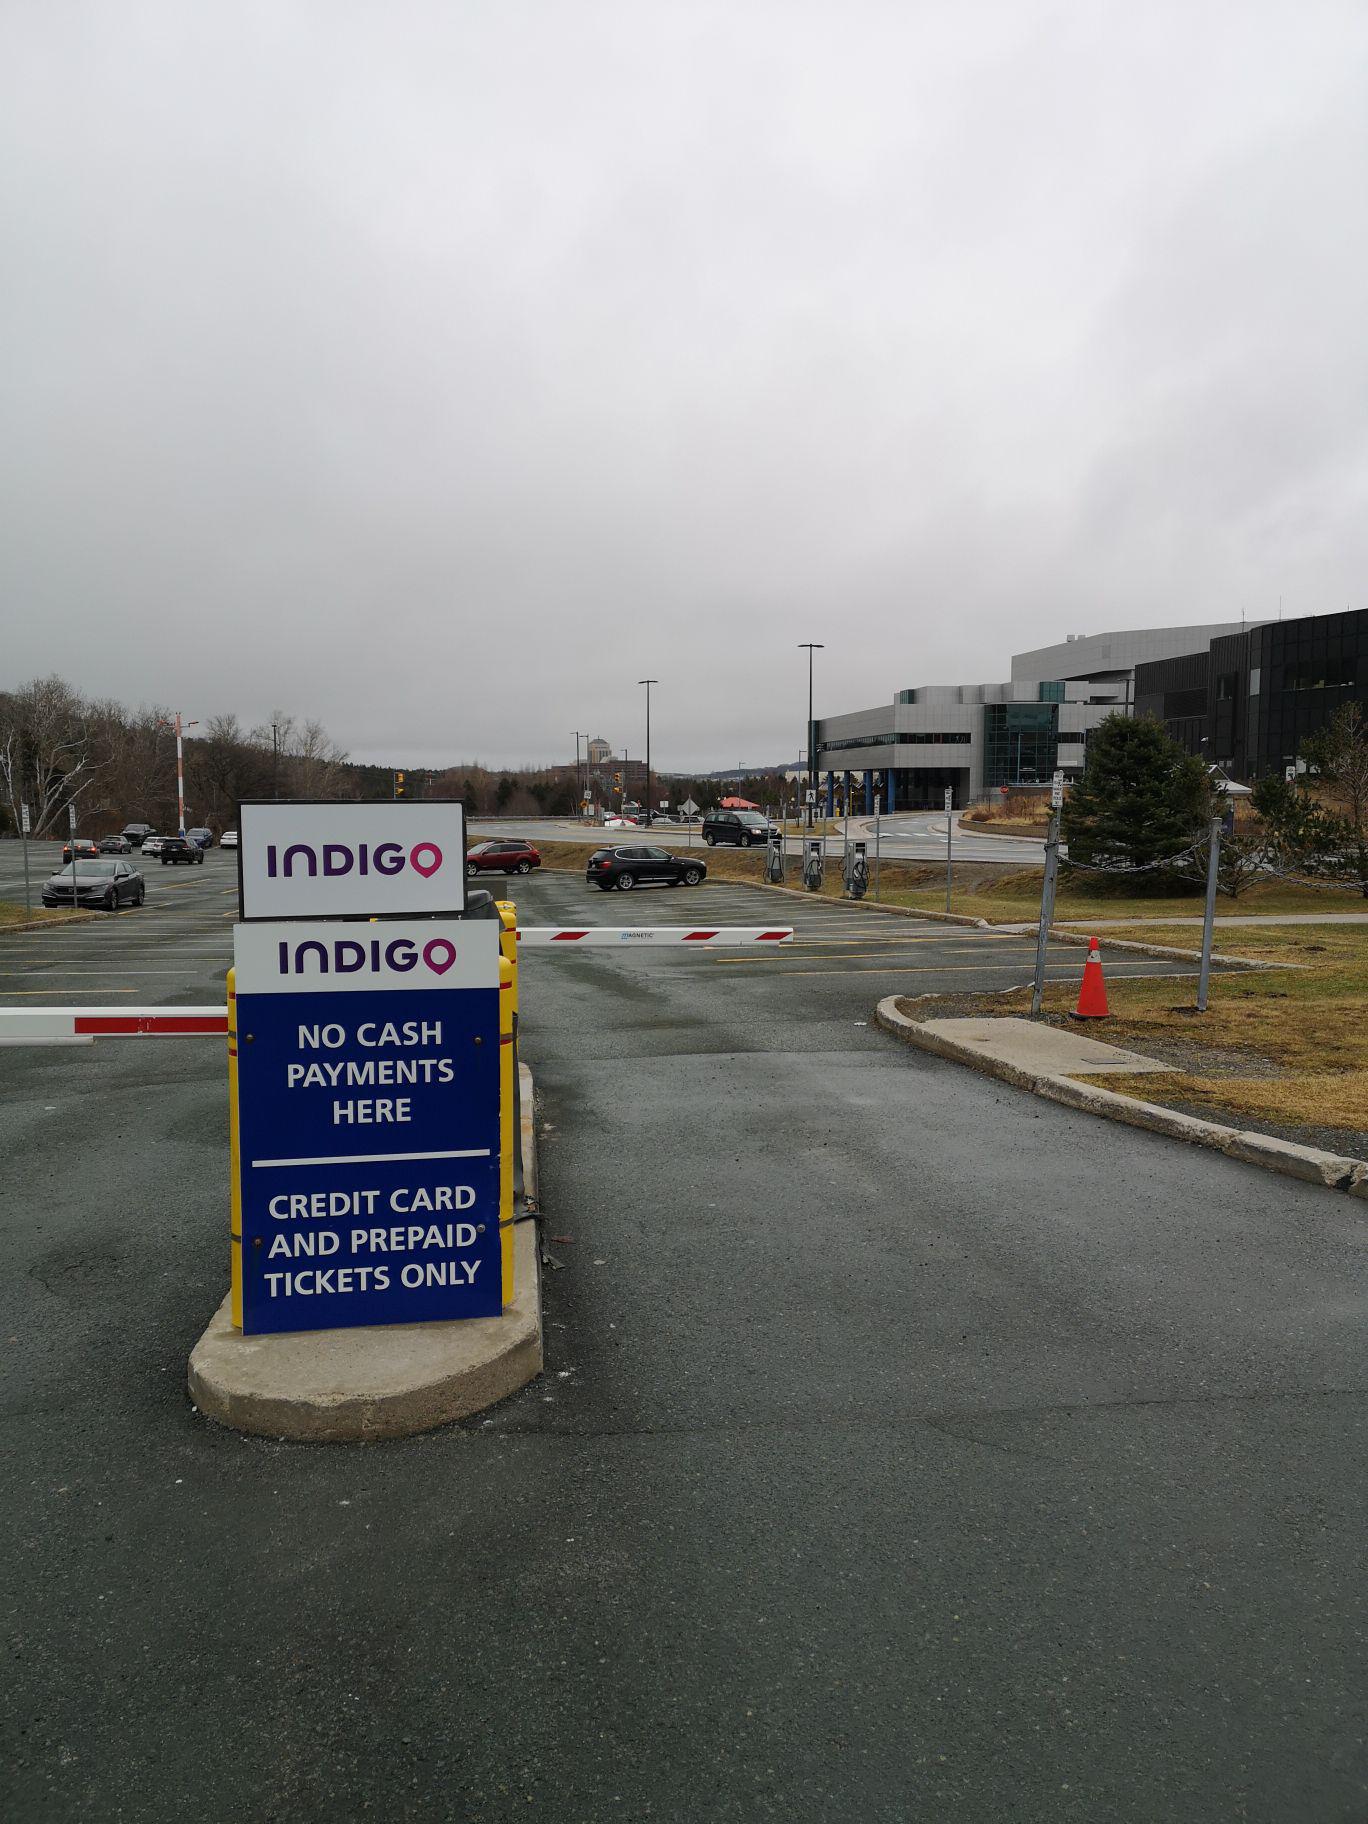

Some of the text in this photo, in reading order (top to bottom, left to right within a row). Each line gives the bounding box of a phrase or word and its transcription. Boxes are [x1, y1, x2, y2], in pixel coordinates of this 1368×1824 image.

[267, 842, 443, 879] INDIGO
[278, 938, 457, 976] INDIGO
[298, 1021, 442, 1049] NO CASH
[287, 1058, 455, 1088] PAYMENTS
[333, 1097, 412, 1125] HERE
[268, 1185, 476, 1220] CREDIT CARD
[267, 1223, 478, 1259] AND PREPAID
[263, 1259, 482, 1298] TICKETS ONLY
